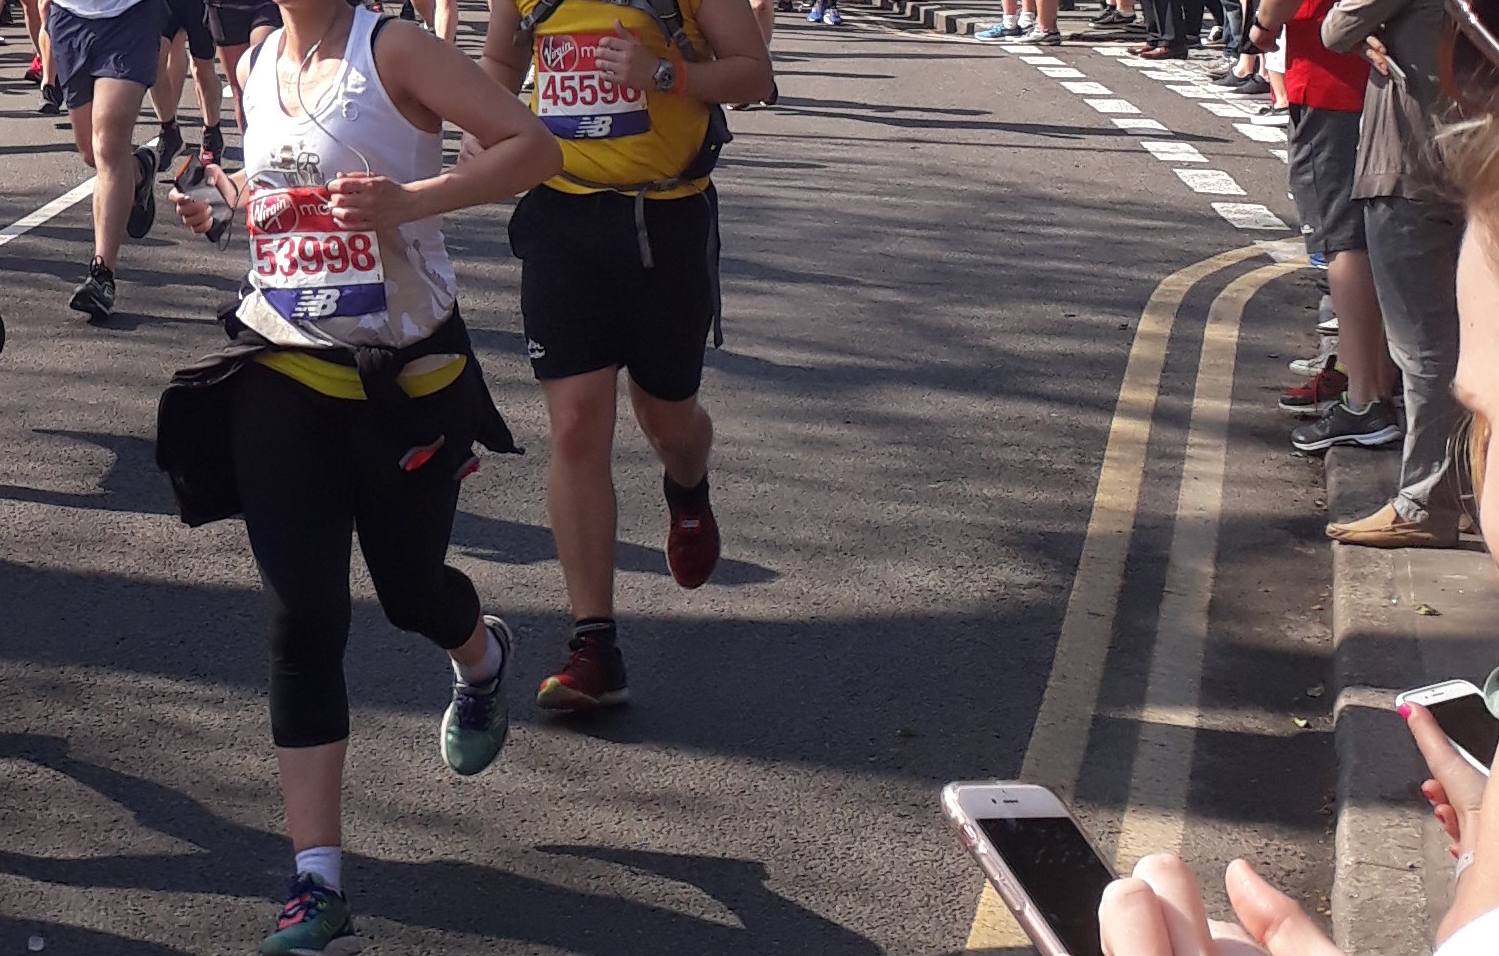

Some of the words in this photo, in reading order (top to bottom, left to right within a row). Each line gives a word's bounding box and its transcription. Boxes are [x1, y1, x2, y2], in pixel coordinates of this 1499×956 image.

[544, 35, 575, 70] Virgin
[253, 196, 292, 231] Virgin
[256, 233, 377, 277] 53998
